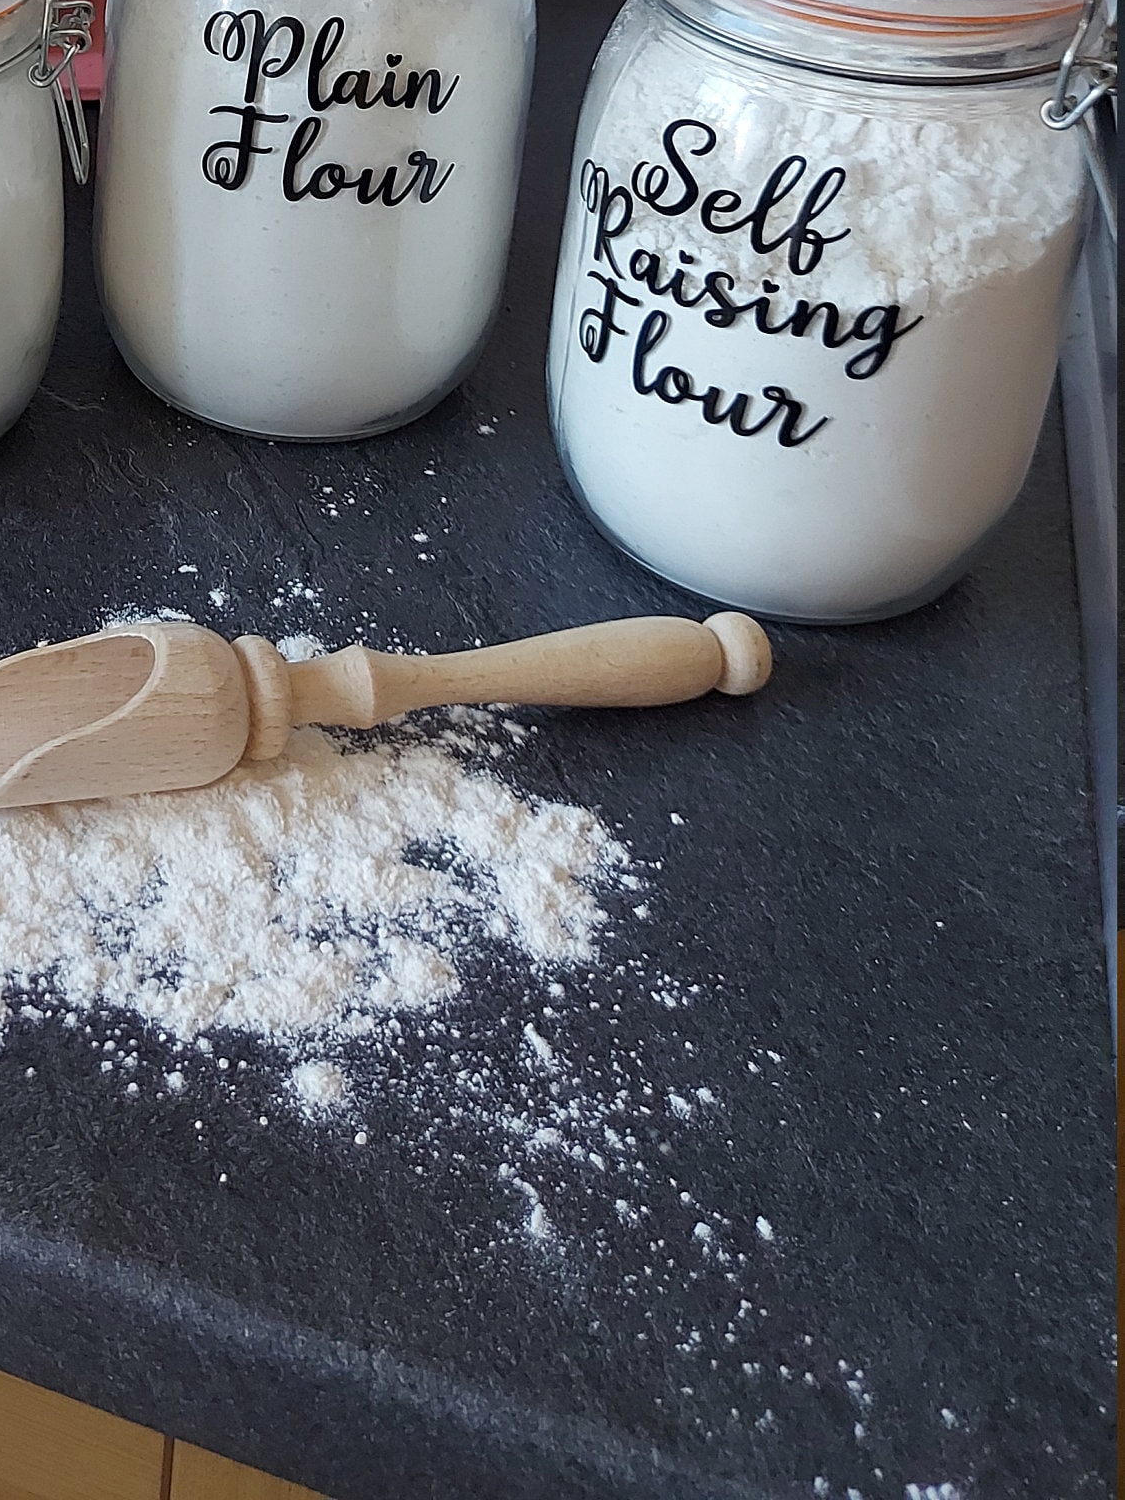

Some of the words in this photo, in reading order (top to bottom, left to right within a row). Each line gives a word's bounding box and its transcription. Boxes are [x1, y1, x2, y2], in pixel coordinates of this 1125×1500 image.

[203, 9, 460, 114] Plain
[202, 105, 455, 207] Flour
[631, 118, 852, 276] Self
[580, 159, 925, 380] Raising
[579, 270, 829, 448] Flour
